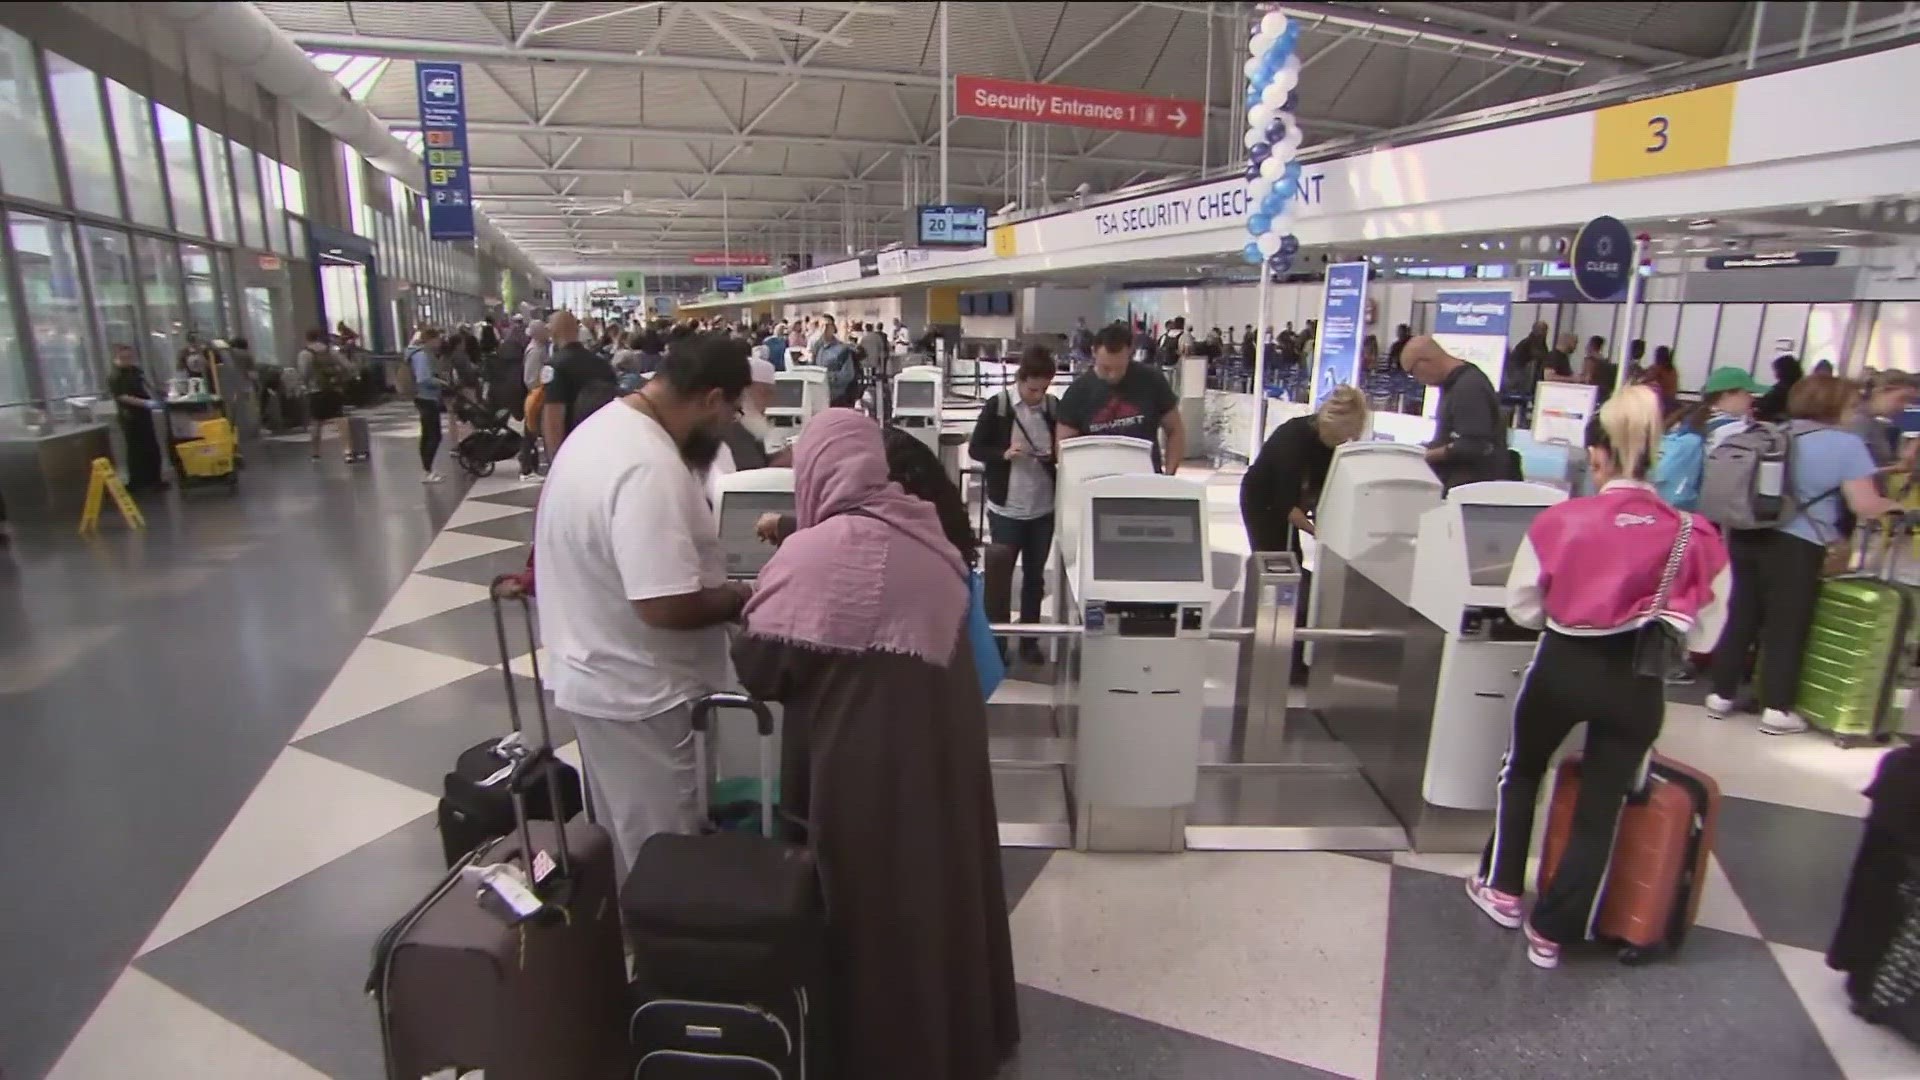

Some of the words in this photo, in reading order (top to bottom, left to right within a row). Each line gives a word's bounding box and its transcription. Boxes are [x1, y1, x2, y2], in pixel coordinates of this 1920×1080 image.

[974, 89, 1046, 116] Security
[1051, 97, 1124, 121] Entrance
[1129, 105, 1136, 121] 1
[1645, 116, 1669, 153] 3
[1095, 213, 1119, 235] TSA
[1122, 198, 1192, 230] SECURITY
[1198, 175, 1325, 219] CHECNT
[928, 219, 946, 232] 20
[1586, 261, 1619, 272] CLEAR
